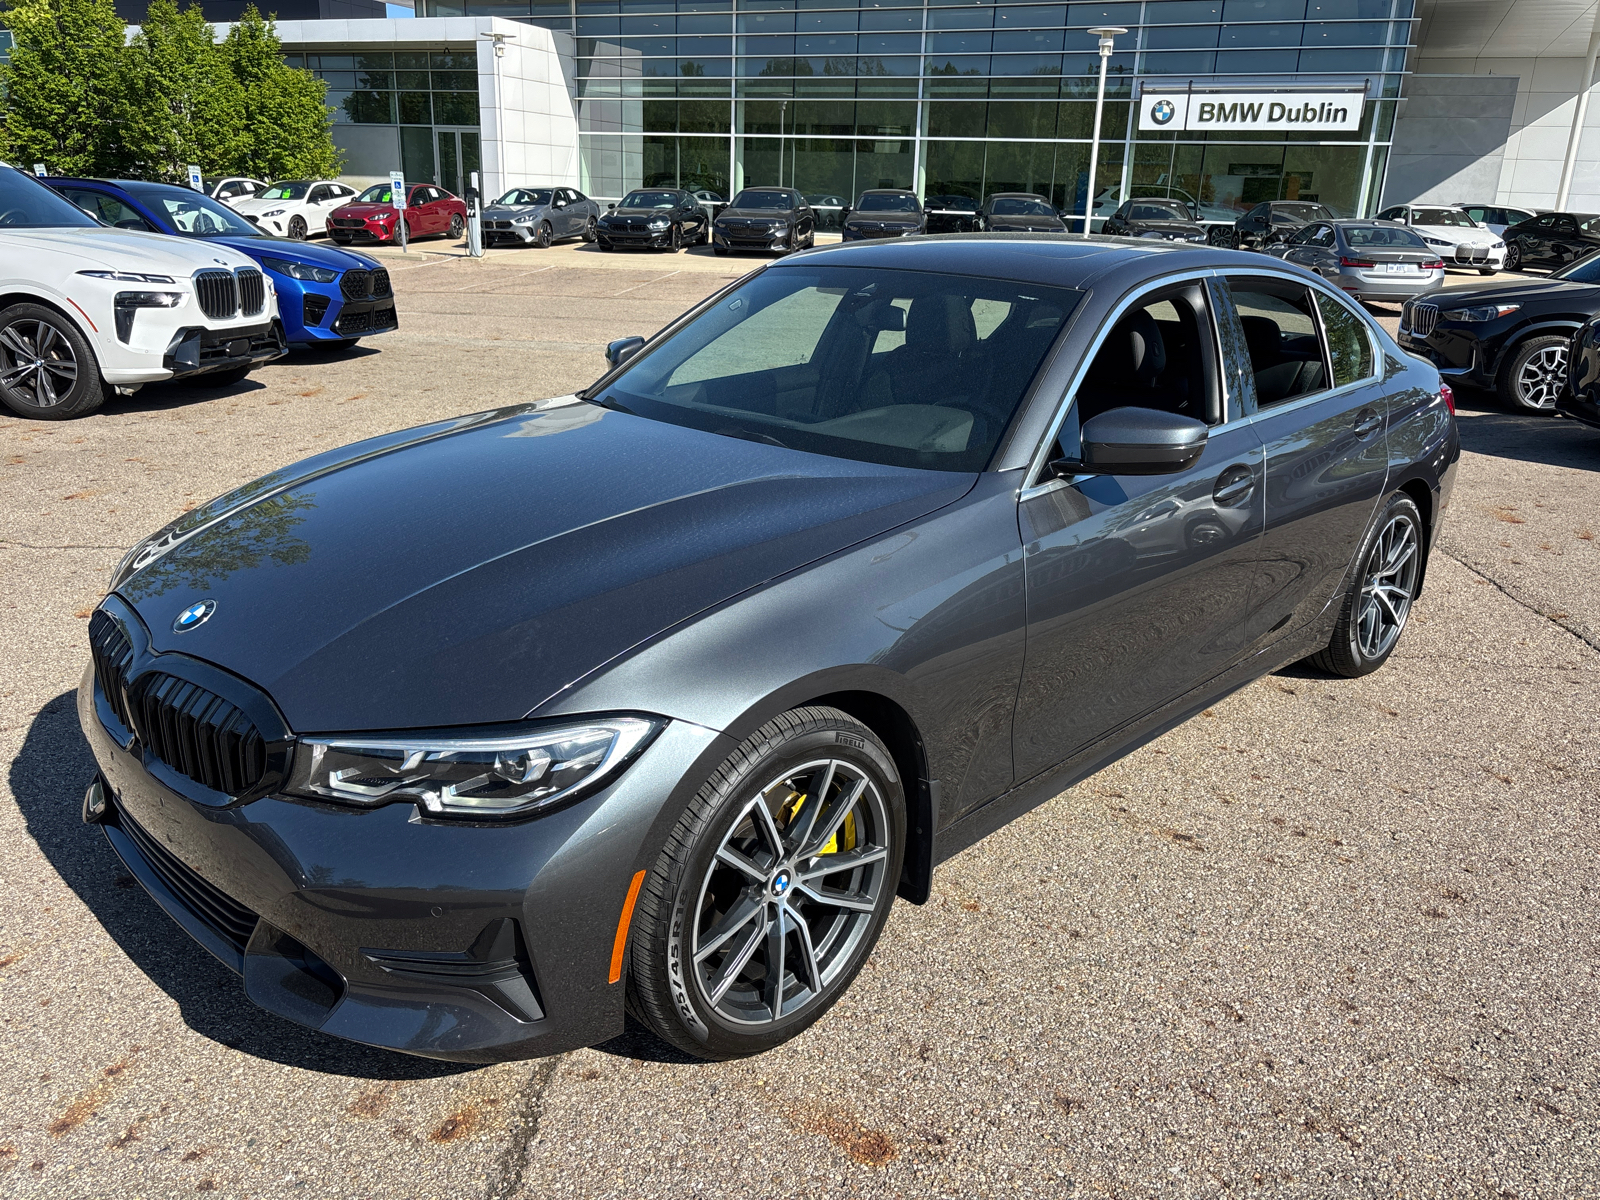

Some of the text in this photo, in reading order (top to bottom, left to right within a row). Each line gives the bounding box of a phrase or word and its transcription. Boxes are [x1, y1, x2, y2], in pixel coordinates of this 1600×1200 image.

[1197, 102, 1348, 123] BMW Dublin
[834, 731, 866, 749] PIRELLI
[671, 943, 698, 1027] 225/45
